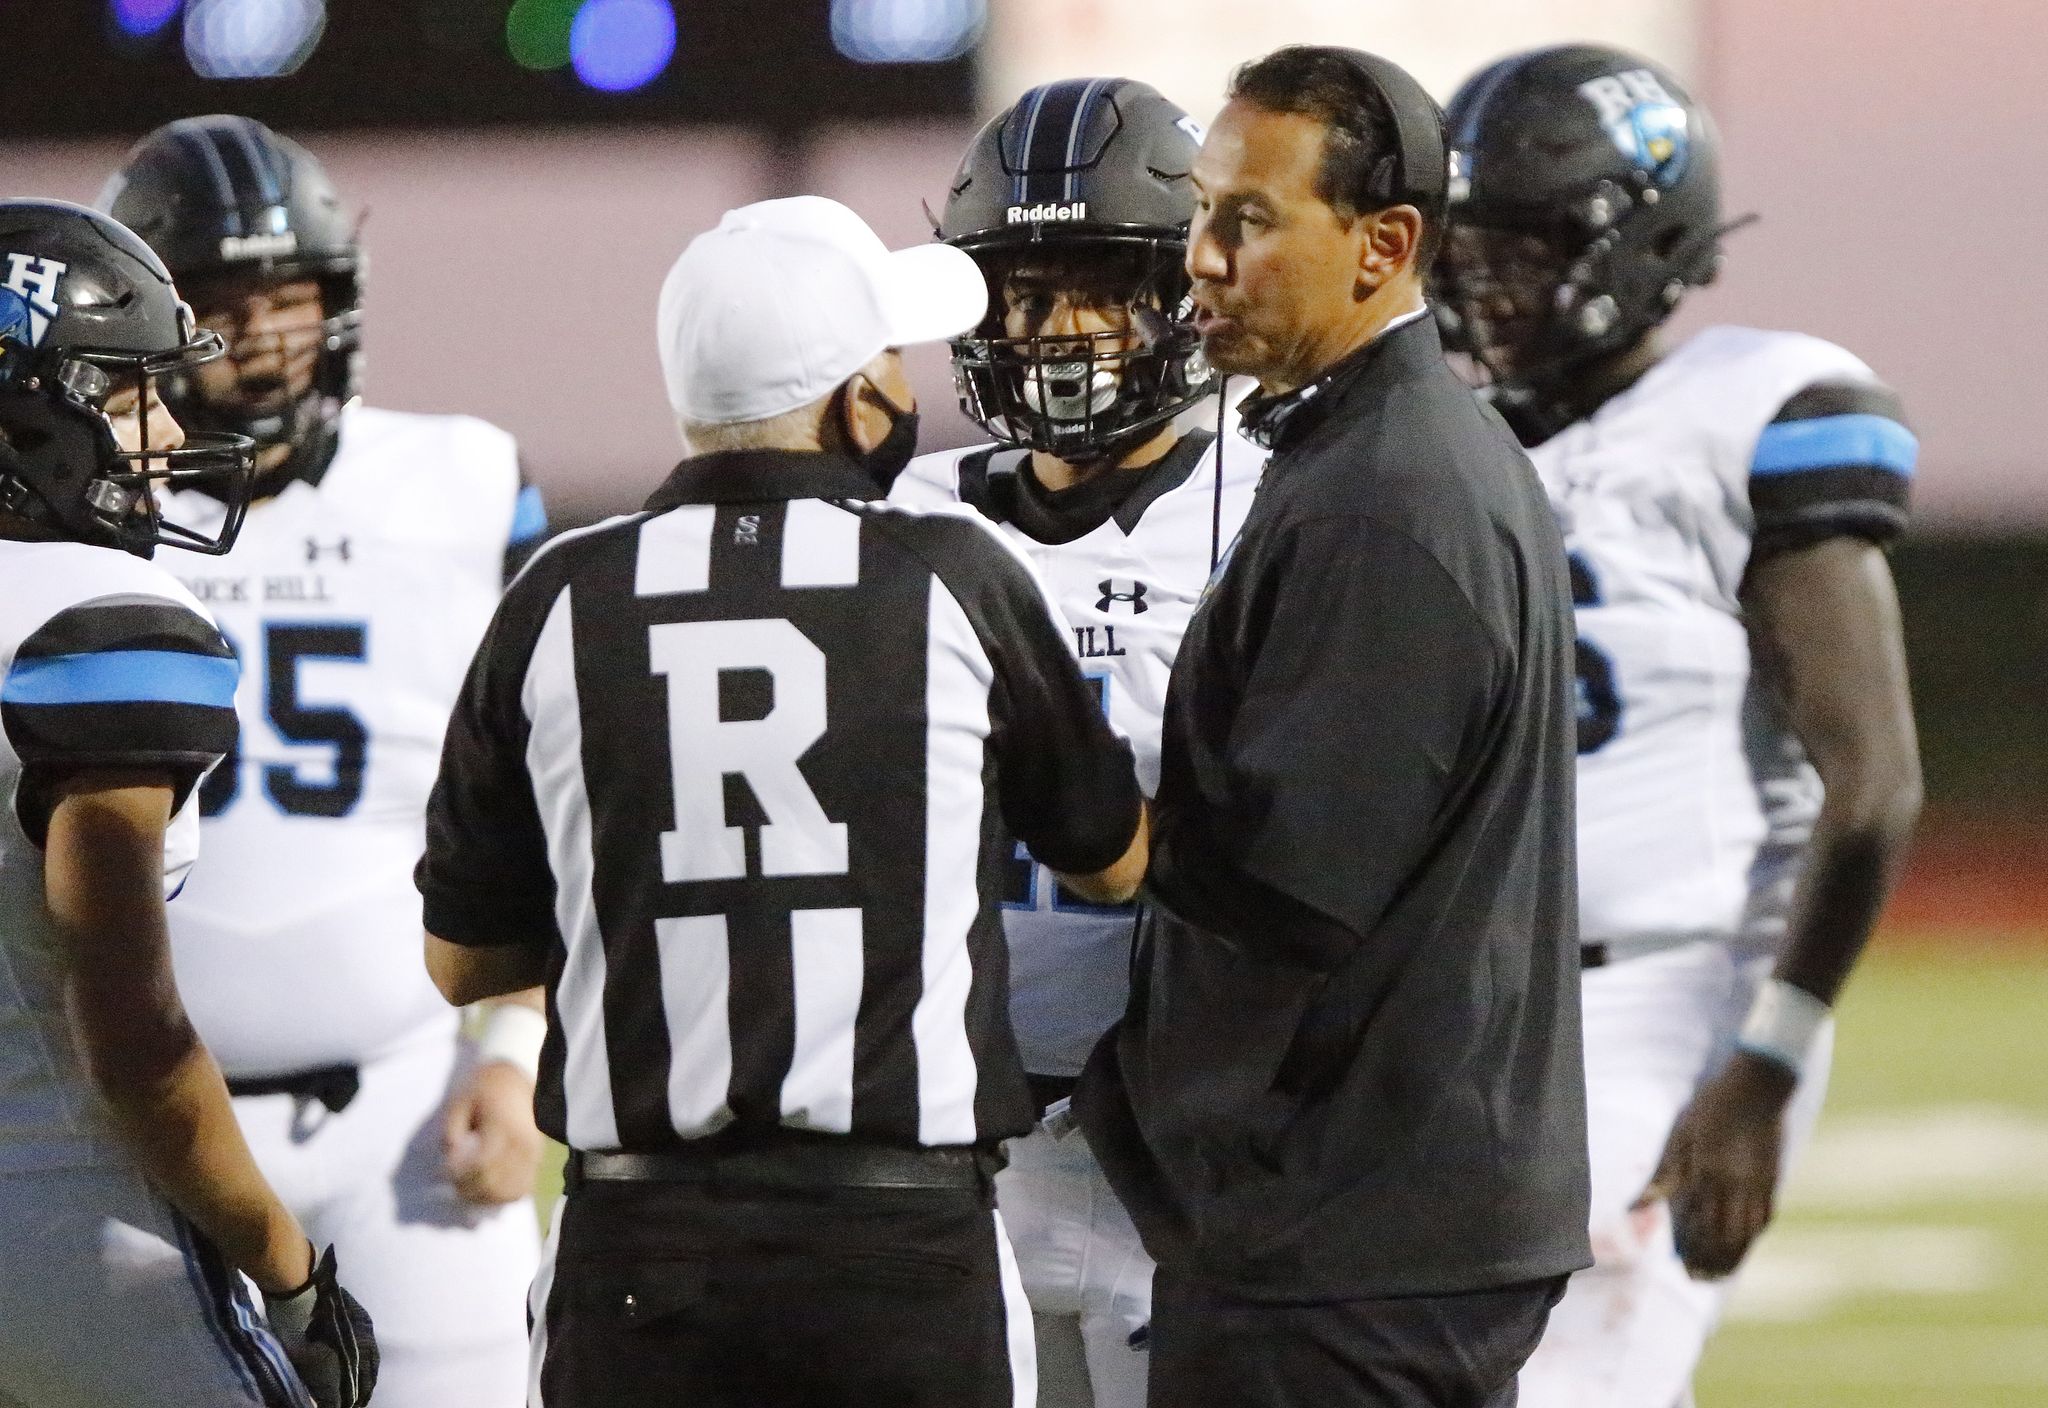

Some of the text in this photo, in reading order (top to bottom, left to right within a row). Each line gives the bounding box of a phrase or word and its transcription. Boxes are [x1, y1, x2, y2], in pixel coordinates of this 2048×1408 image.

[1007, 202, 1086, 224] Riddell
[1053, 420, 1094, 436] Riddel
[1071, 624, 1126, 658] ILL
[648, 617, 849, 883] R
